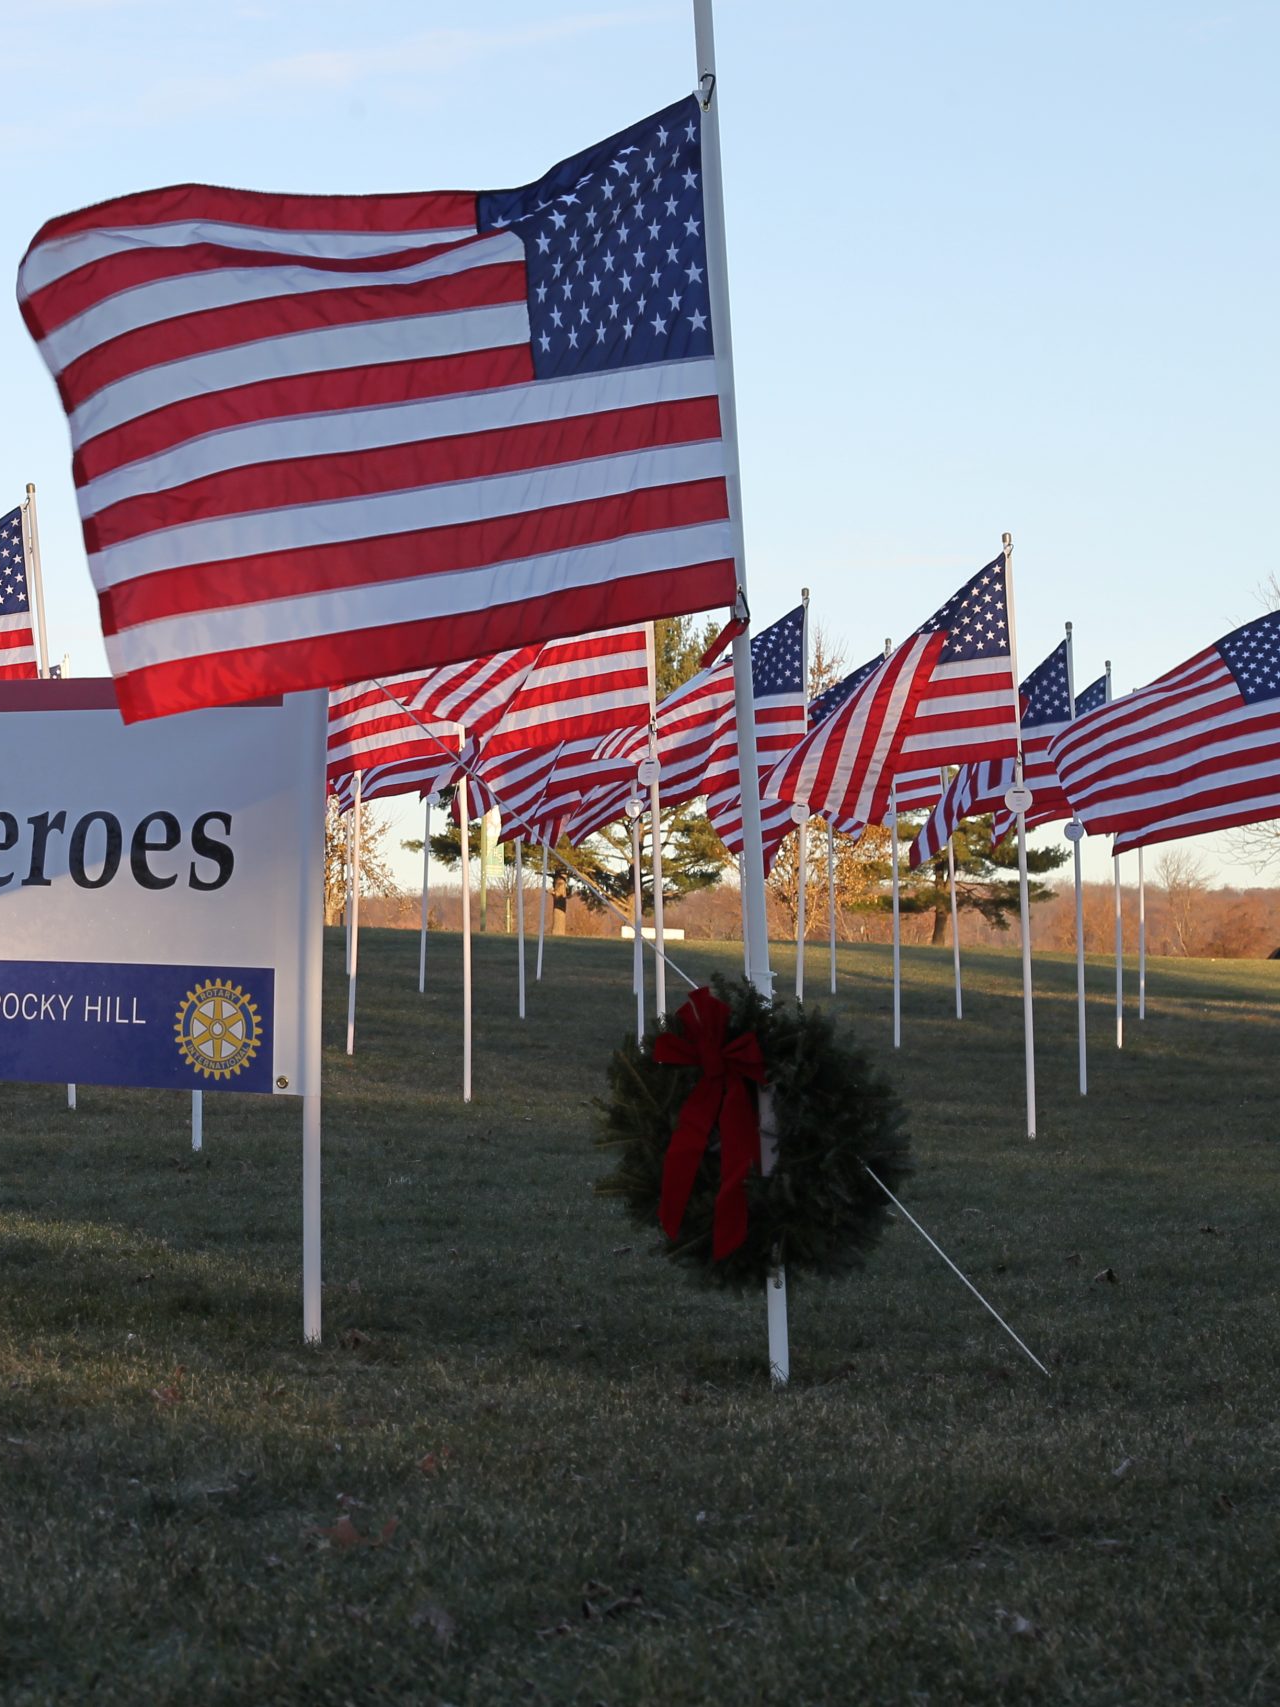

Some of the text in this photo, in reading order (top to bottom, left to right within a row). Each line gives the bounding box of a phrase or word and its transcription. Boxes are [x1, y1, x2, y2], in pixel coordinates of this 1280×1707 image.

[199, 988, 238, 1001] ROTARY
[84, 995, 147, 1024] HILL
[187, 1044, 250, 1069] INTERNATIONAL
